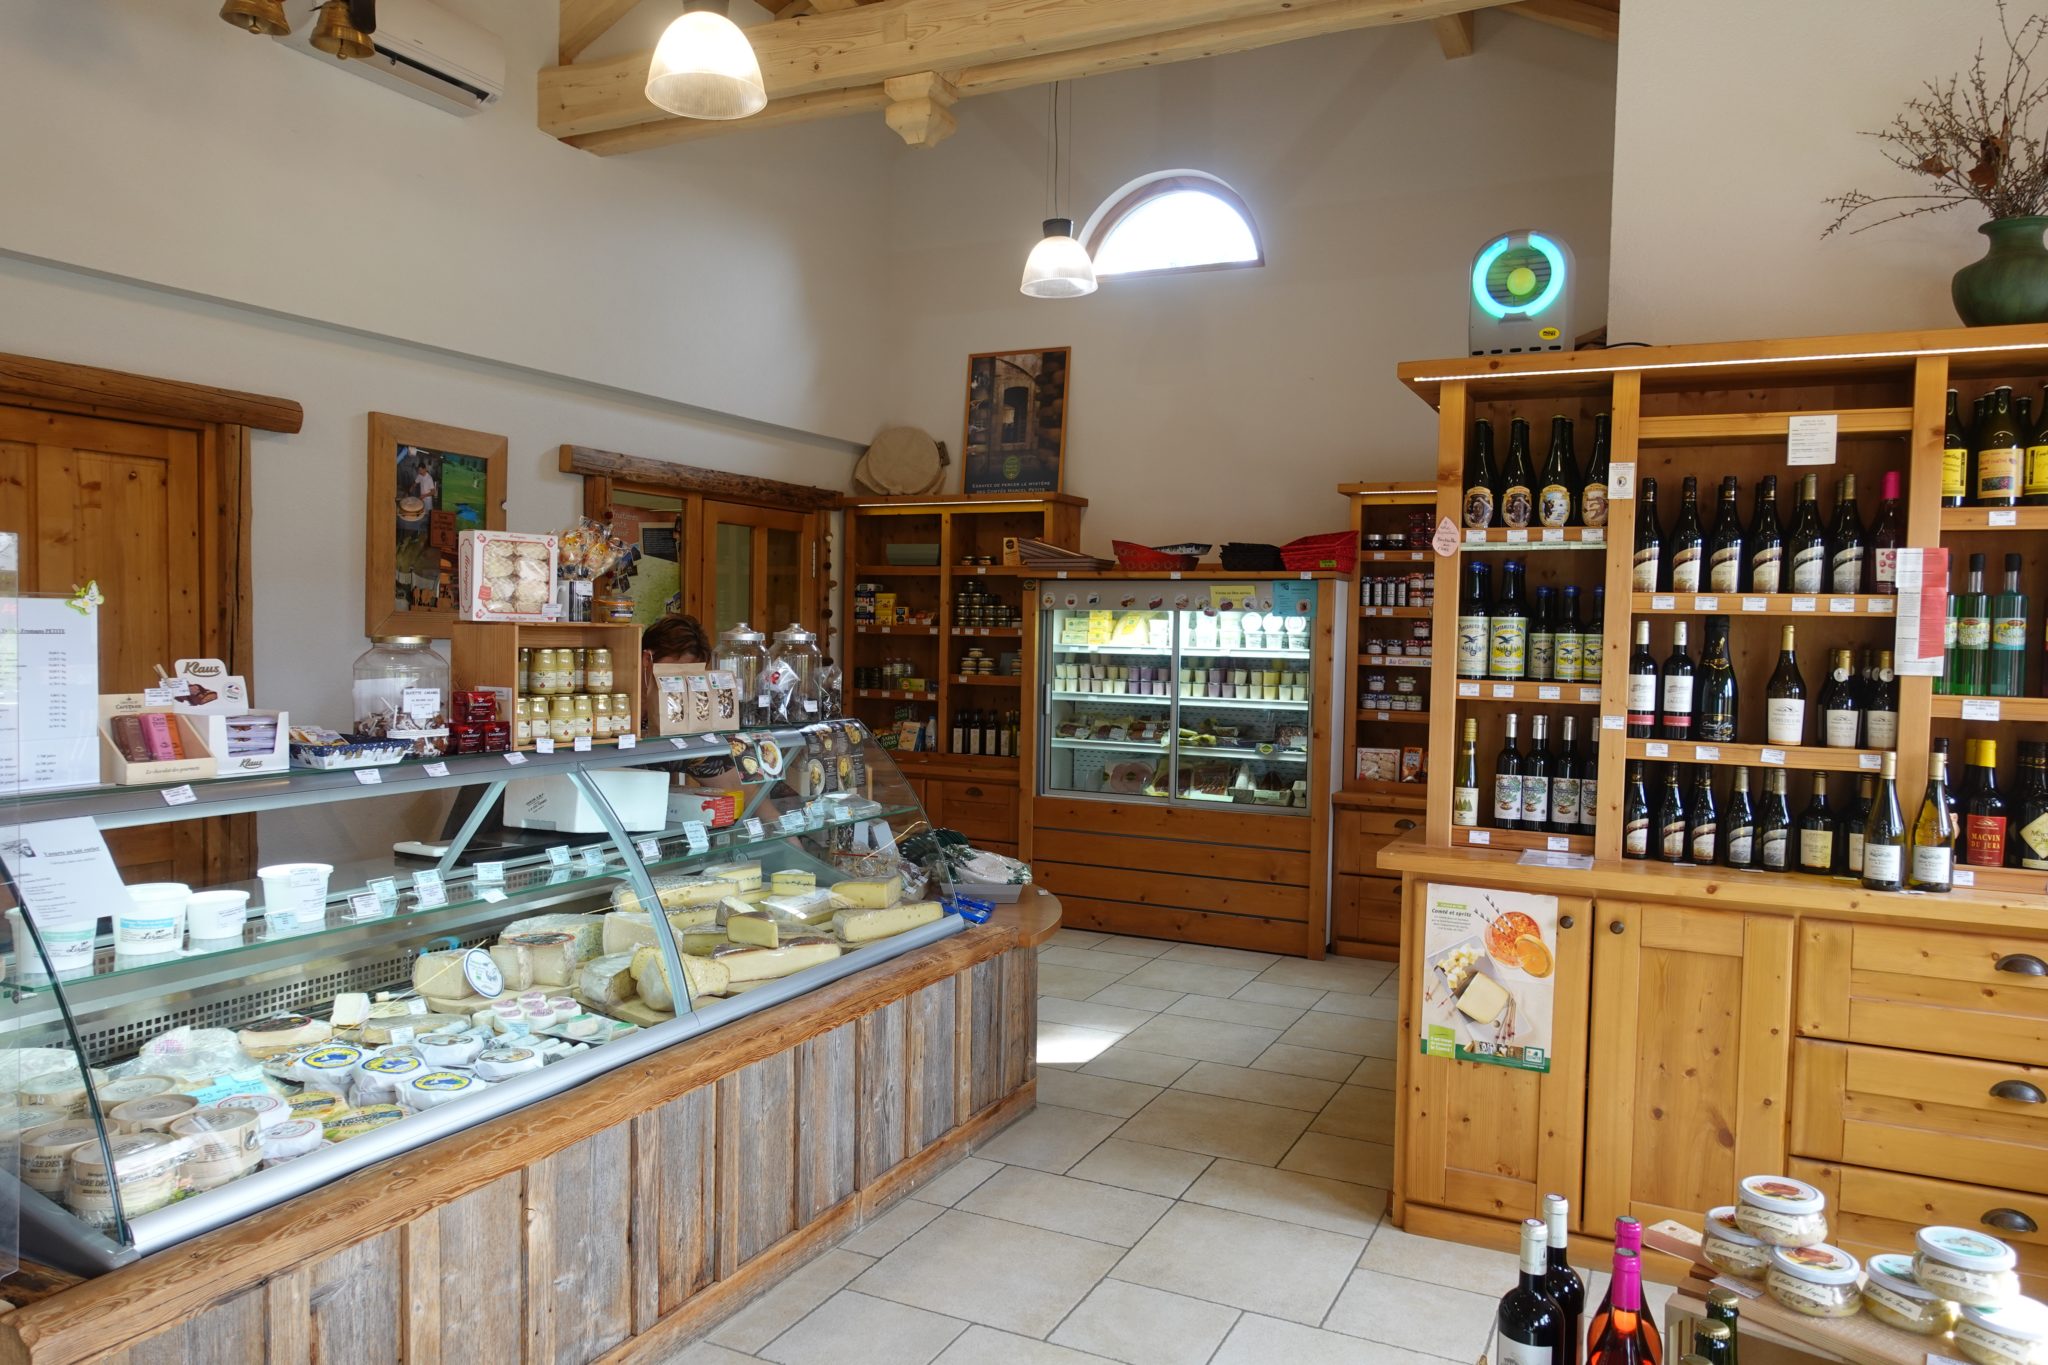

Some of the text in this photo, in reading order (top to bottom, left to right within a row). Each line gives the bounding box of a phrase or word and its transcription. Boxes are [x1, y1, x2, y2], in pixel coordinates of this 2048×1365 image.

[183, 662, 222, 677] Klaus
[239, 758, 264, 770] Klaus
[1971, 832, 2001, 841] MACVIN
[1984, 842, 2001, 850] JURA
